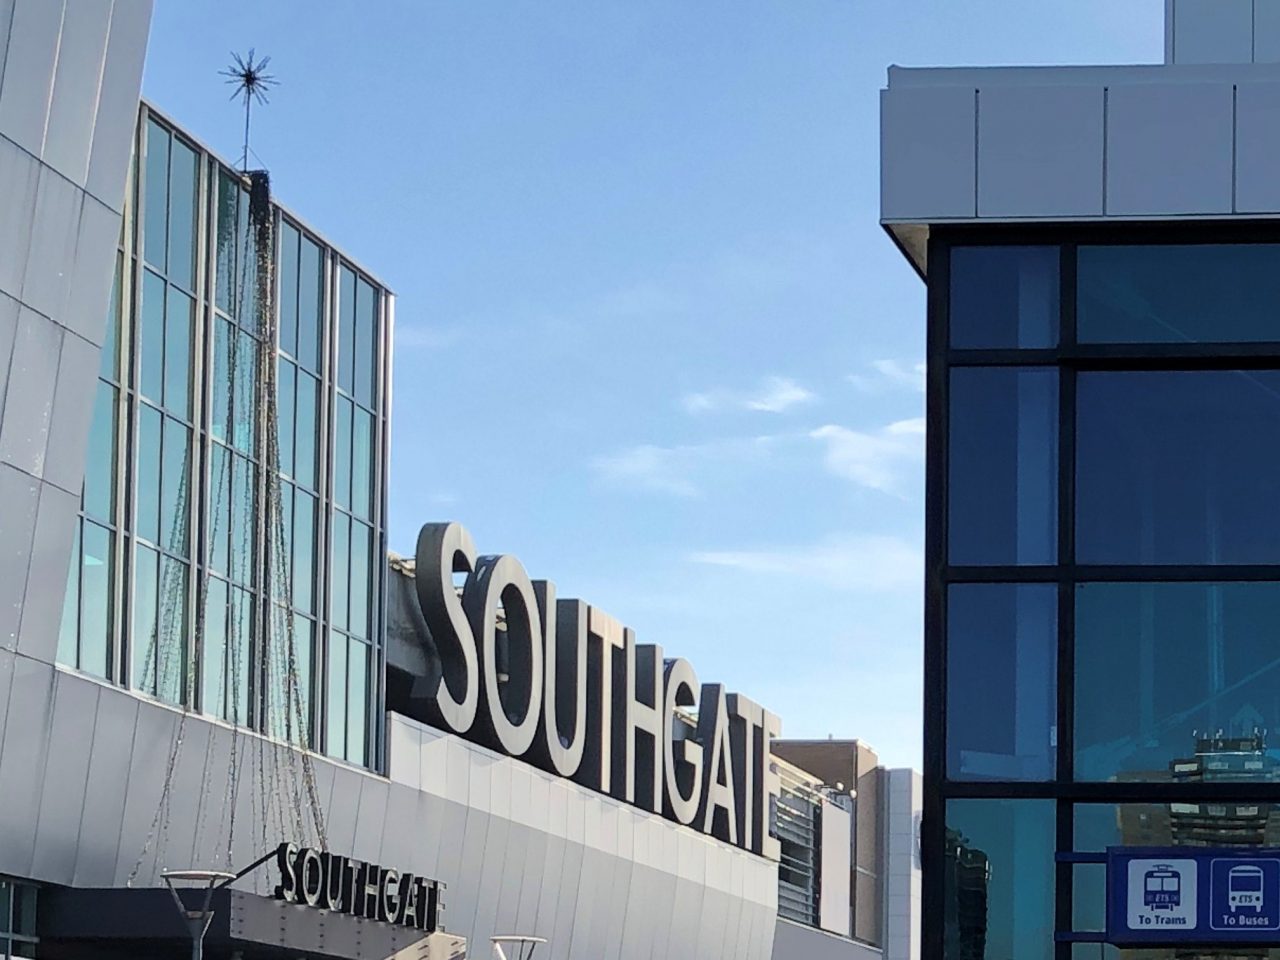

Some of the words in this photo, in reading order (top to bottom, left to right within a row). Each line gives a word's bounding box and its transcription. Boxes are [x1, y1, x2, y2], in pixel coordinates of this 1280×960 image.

[416, 521, 782, 862] SOUTHGATE
[276, 841, 447, 933] SOUTHGATE
[1138, 914, 1152, 926] To
[1154, 914, 1187, 926] Trains
[1222, 915, 1236, 926] To
[1238, 915, 1269, 926] Buses
